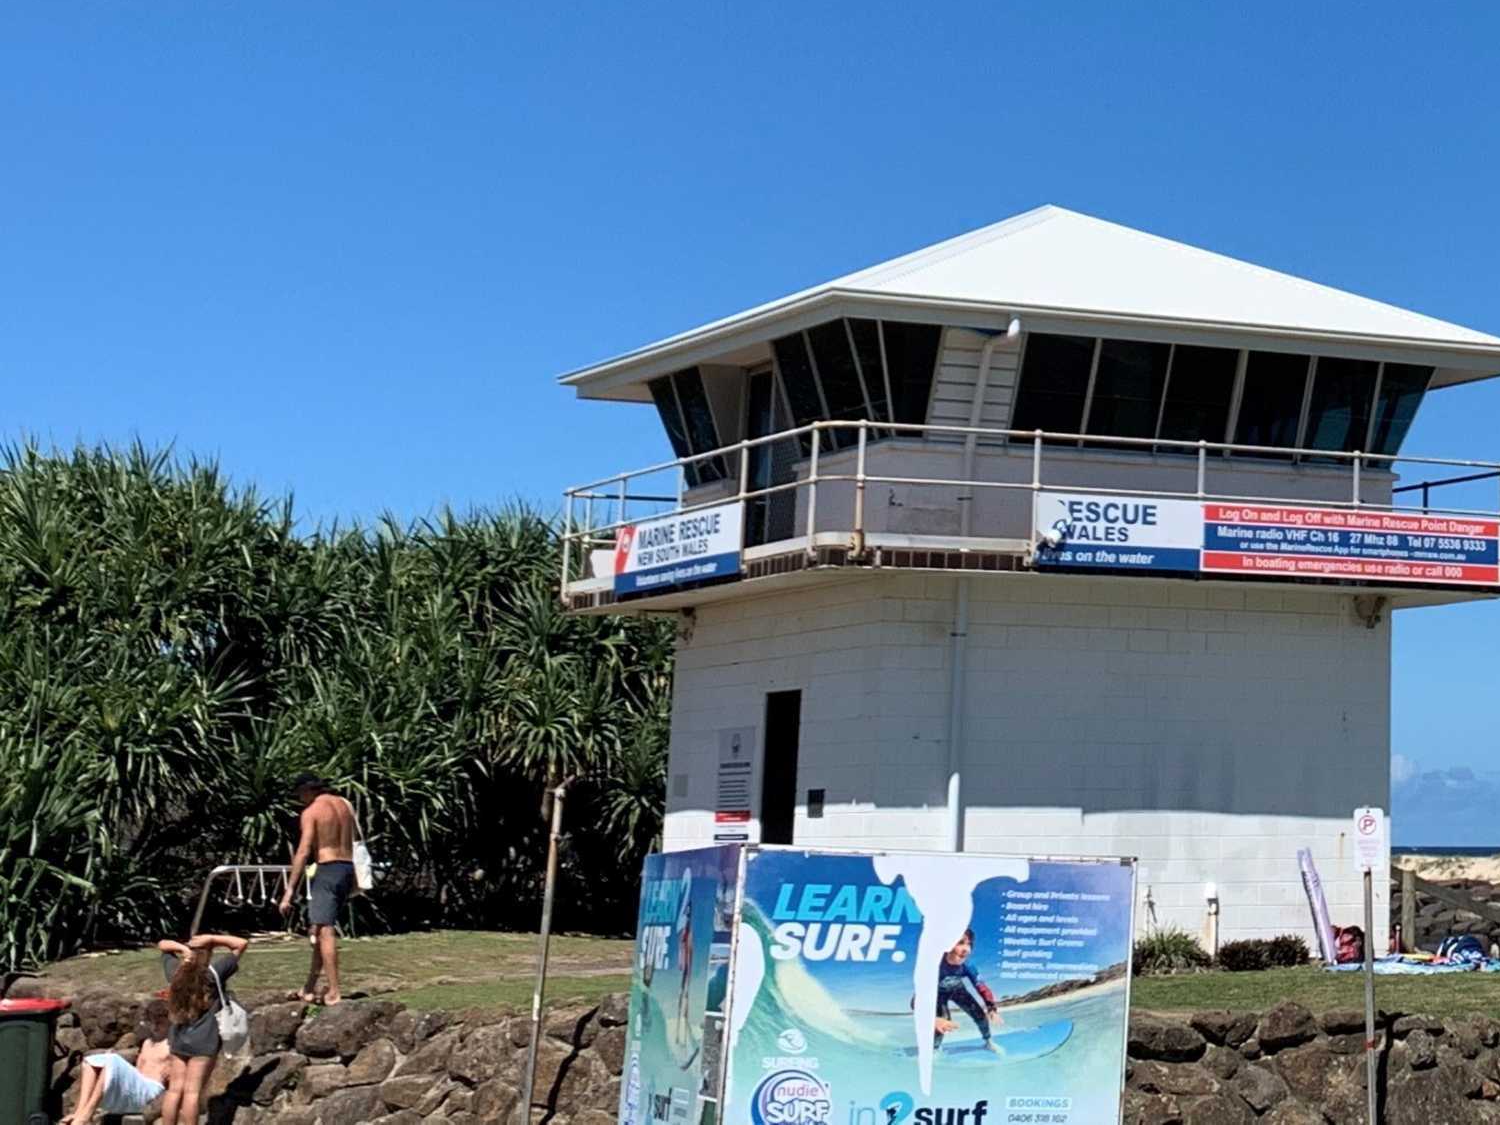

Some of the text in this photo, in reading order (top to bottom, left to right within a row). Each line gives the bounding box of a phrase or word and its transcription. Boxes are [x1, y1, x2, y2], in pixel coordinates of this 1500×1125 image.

[1058, 500, 1157, 525] ESCUE
[1219, 508, 1485, 535] Log On and Log Off with Marine Rescue Point Danger
[639, 514, 720, 550] MARINE RESCUE
[1217, 526, 1339, 543] Marine radio VHF Ch 16
[1350, 533, 1361, 544] 27
[1364, 534, 1384, 546] Mhz
[1407, 536, 1486, 551] Tel 07 5536 9333
[638, 539, 708, 565] NEW SOUTH WALES
[1075, 551, 1092, 563] on
[1096, 549, 1115, 563] the
[1118, 551, 1155, 564] water
[1243, 556, 1253, 566] In
[1255, 557, 1296, 571] boating
[1298, 561, 1362, 573] emergencies
[1364, 564, 1382, 573] use
[1385, 564, 1409, 575] radio
[1412, 566, 1423, 575] or
[1425, 566, 1443, 576] call
[1007, 890, 1032, 900] Group
[1033, 891, 1050, 899] and
[772, 883, 923, 923] LEARN
[1039, 915, 1055, 923] and
[769, 922, 906, 962] SURF.
[1038, 938, 1056, 946] Surf
[1002, 949, 1021, 957] Surf
[762, 1057, 819, 1069] SURFING
[777, 1082, 820, 1097] nudie
[1009, 1098, 1069, 1108] BOOKINGS
[766, 1100, 830, 1123] SURF
